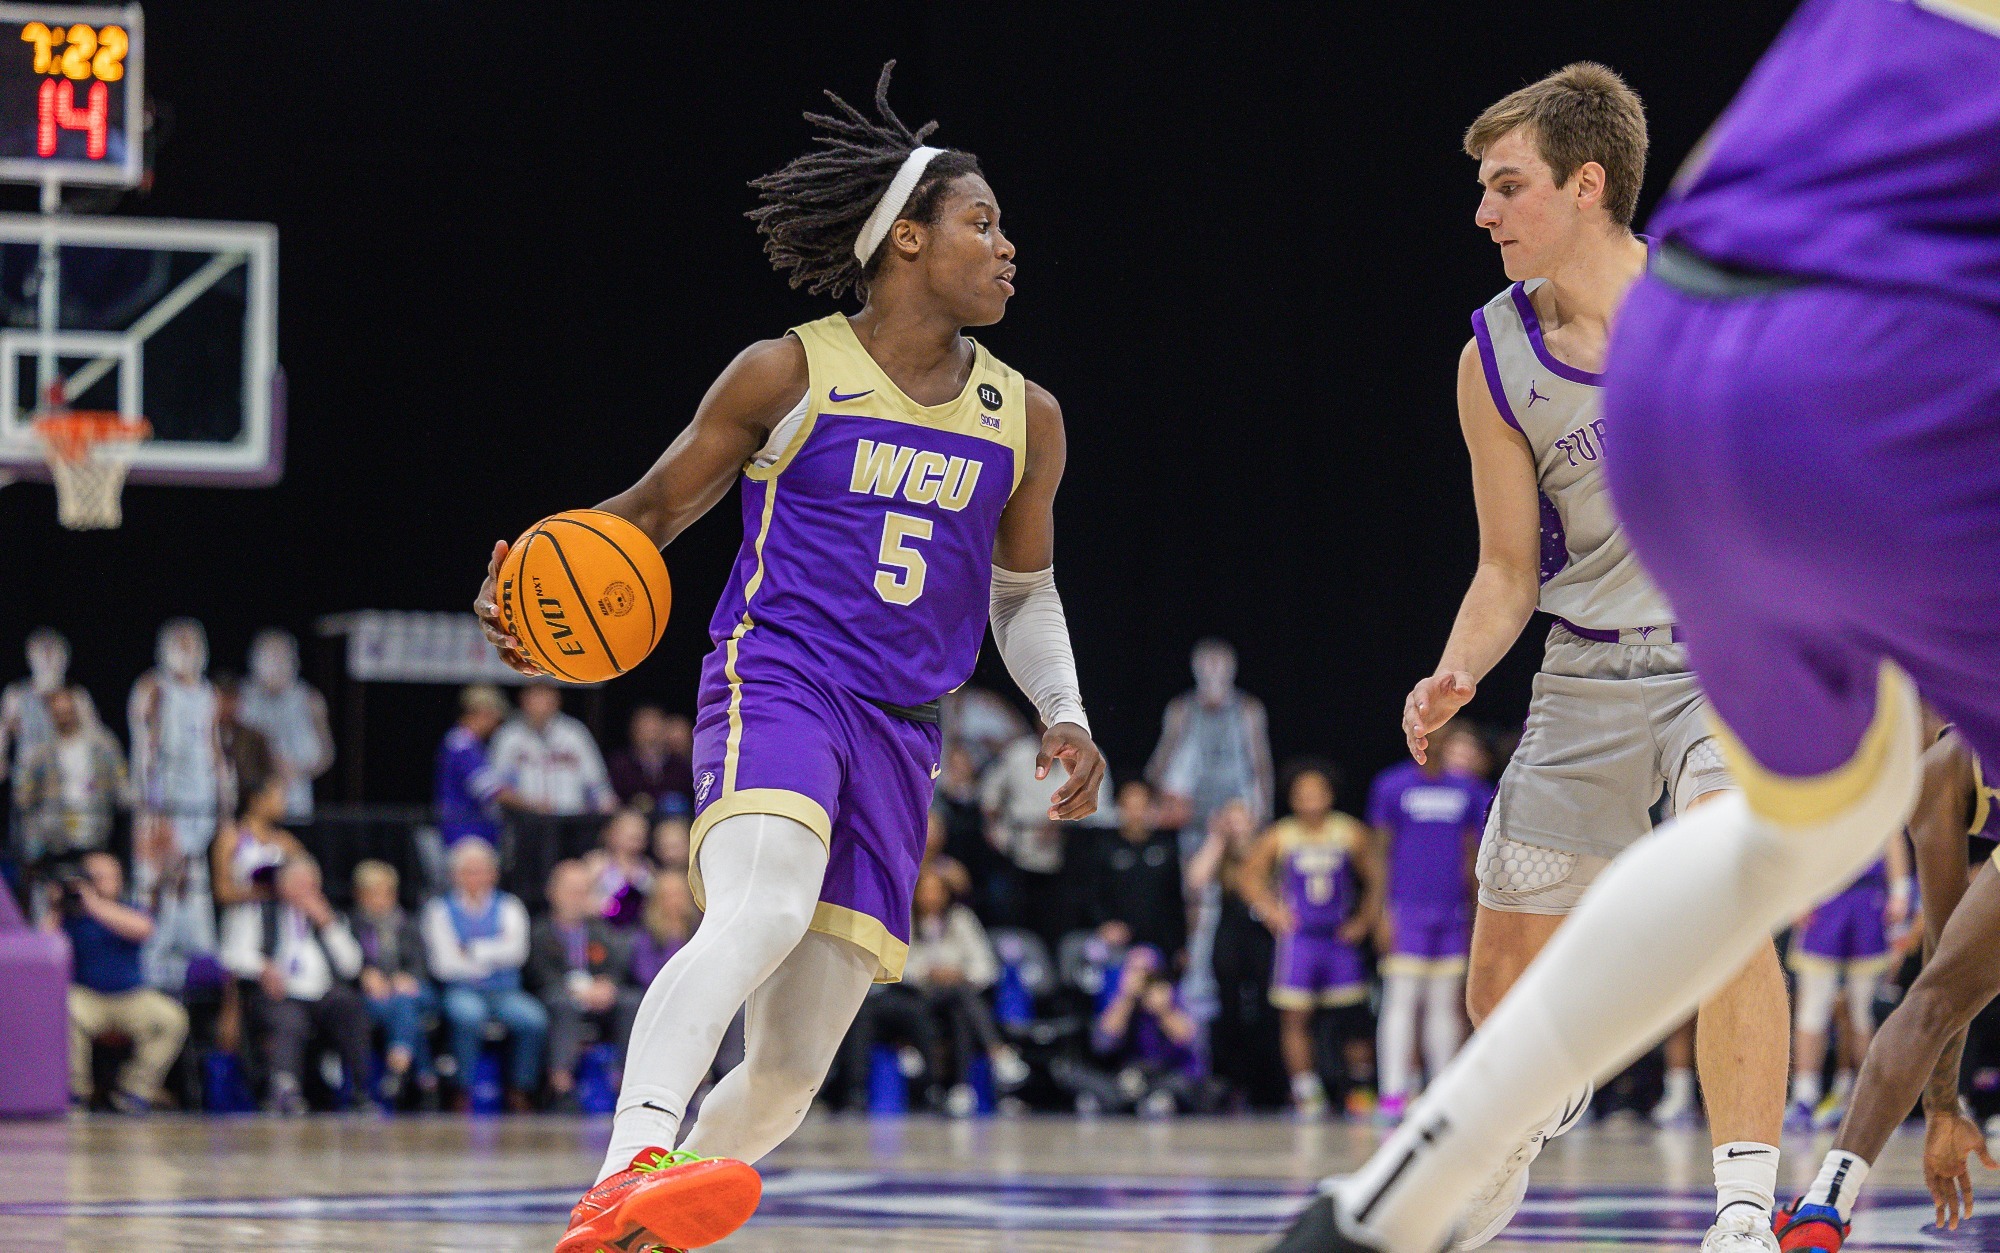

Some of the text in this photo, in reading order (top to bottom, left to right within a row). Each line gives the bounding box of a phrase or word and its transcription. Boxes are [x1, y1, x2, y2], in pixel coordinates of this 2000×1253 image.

[21, 22, 129, 81] 7:22
[37, 77, 108, 159] 14
[980, 387, 1000, 405] HL
[849, 438, 983, 512] WCU
[532, 575, 544, 597] NXT
[873, 511, 934, 606] 5
